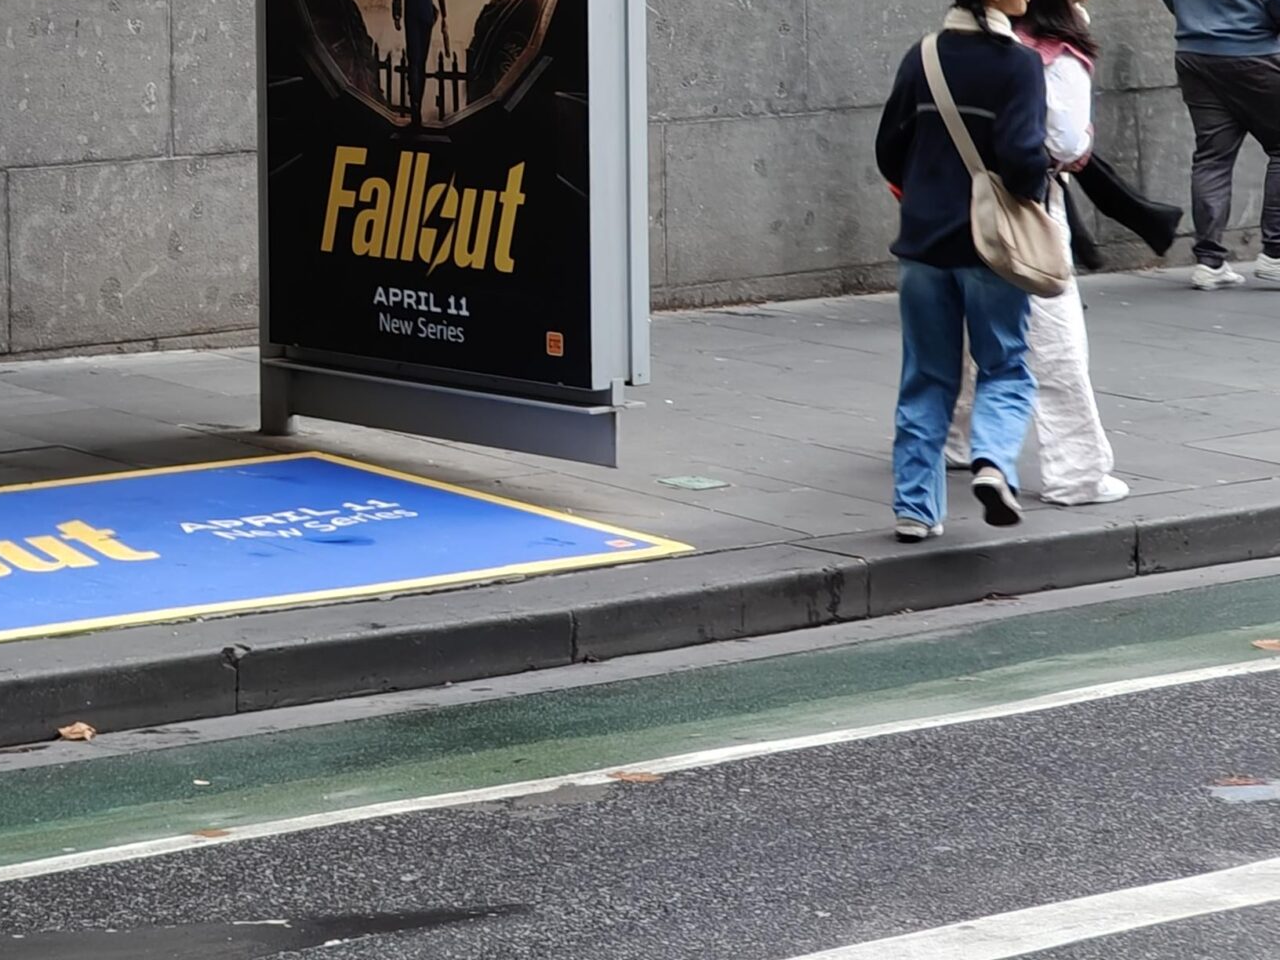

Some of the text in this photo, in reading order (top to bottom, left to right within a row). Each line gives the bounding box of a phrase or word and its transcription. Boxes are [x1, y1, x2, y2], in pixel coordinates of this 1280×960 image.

[320, 145, 526, 277] Fallout
[373, 286, 470, 316] APRIL 11
[378, 312, 465, 343] New Series
[179, 498, 401, 534] APRIL 11
[212, 508, 419, 541] New Series
